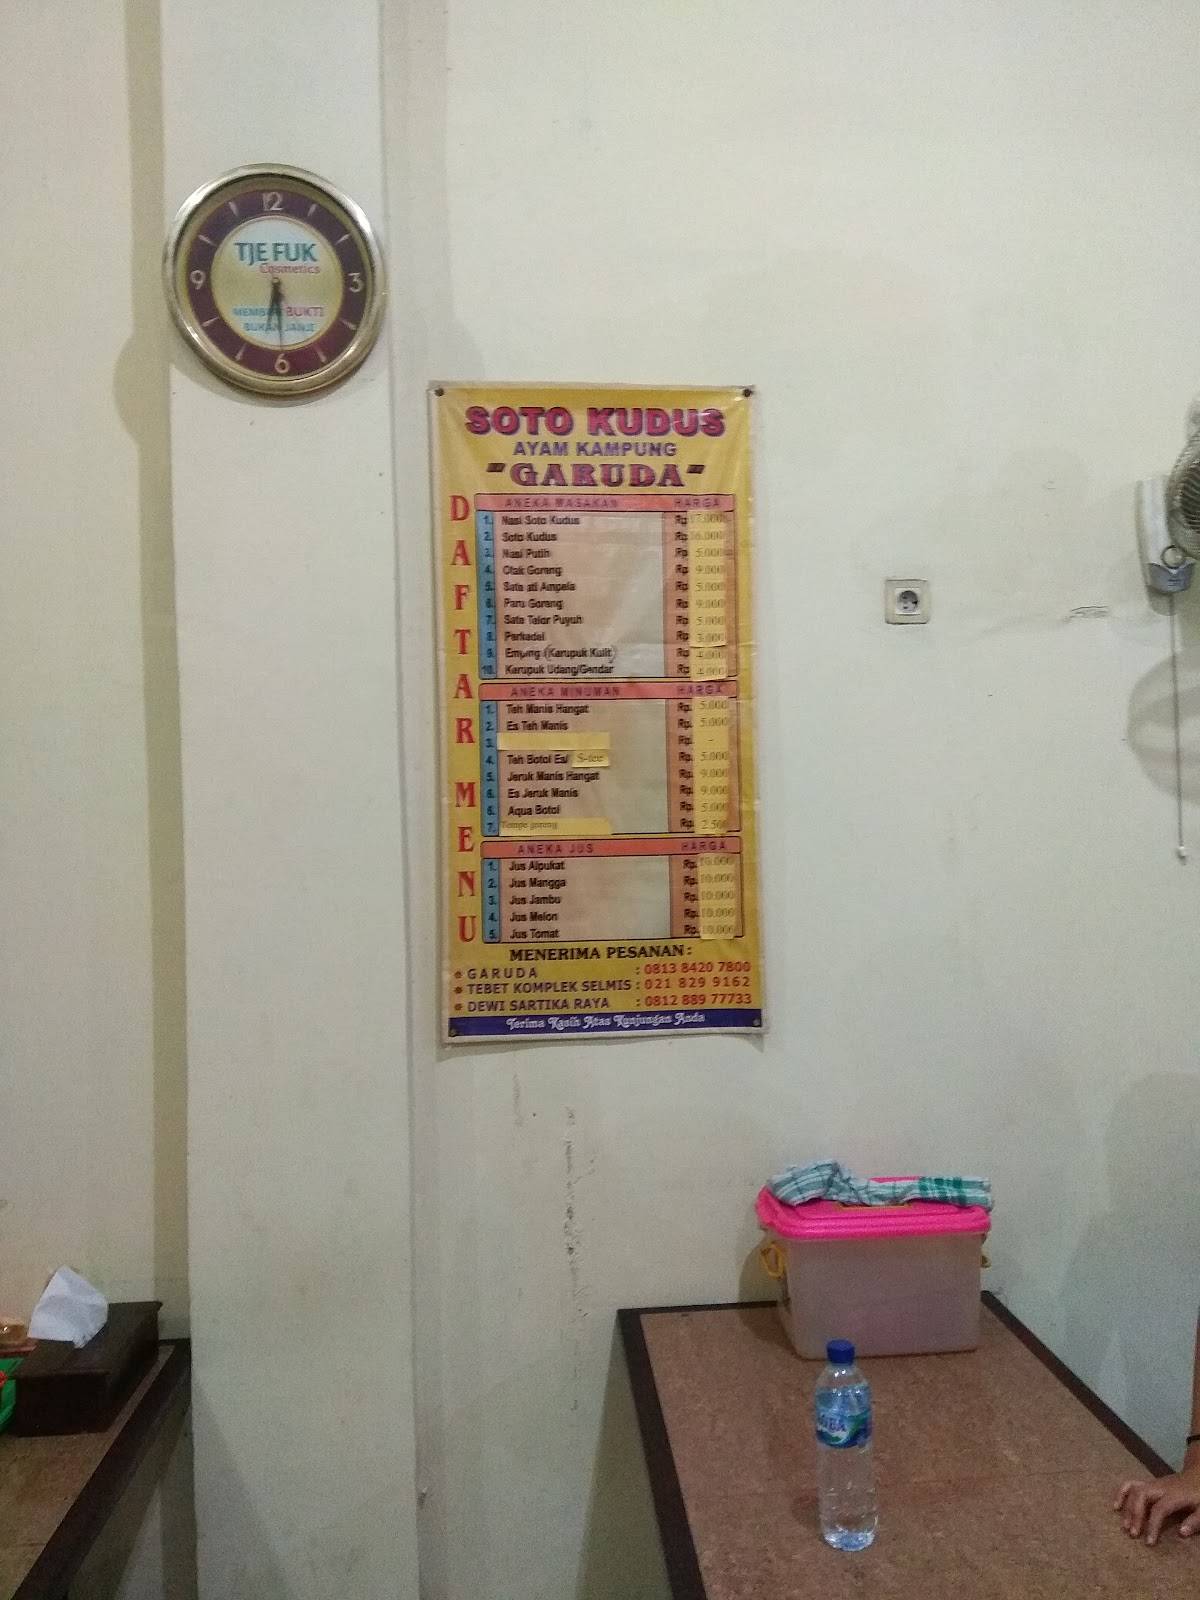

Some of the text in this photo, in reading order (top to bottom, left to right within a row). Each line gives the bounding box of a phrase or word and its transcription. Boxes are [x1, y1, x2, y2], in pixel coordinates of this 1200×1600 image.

[262, 192, 284, 211] 12
[233, 242, 318, 265] TJE FUK
[259, 263, 320, 274] Cosmetics
[189, 270, 206, 290] 9
[348, 272, 364, 292] 3
[274, 353, 290, 373] 6
[465, 406, 726, 437] SOTO KUDUS
[513, 441, 677, 457] AYAM KAMPUNG
[505, 498, 618, 508] ANEKA MASAKAN
[674, 498, 720, 508] HARGA
[502, 515, 522, 525] Nasi
[525, 515, 546, 525] Soto
[550, 515, 580, 525] Kudus
[502, 532, 524, 541] Soto
[526, 532, 557, 541] Kudus
[502, 549, 550, 558] Nasi Putih
[527, 565, 563, 577] Goreng
[528, 598, 564, 610] Goreng
[511, 687, 620, 697] ANEKA MINUMAN
[677, 685, 721, 695] HARGA
[506, 704, 524, 714] Teh
[526, 704, 553, 714] Manis
[556, 704, 589, 715] Hangat
[507, 721, 519, 731] Es
[521, 721, 538, 731] Teh
[541, 721, 568, 731] Manis
[507, 754, 524, 764] Teh
[527, 754, 552, 764] Botol
[507, 771, 534, 781] Jeruk
[536, 771, 563, 781] Manis
[566, 771, 600, 782] Hangat
[508, 789, 519, 798] Es
[522, 788, 548, 798] Jeruk
[551, 788, 578, 798] Manis
[508, 806, 532, 817] Aqua
[535, 805, 560, 814] Botol
[518, 843, 594, 854] ANEKA JUS
[681, 841, 725, 851] HARGA
[509, 861, 526, 871] Jus
[528, 861, 565, 872] Alpukat
[509, 878, 526, 888] Jus
[529, 878, 567, 889] Mangga
[509, 895, 526, 905] Jus
[529, 895, 561, 905] Jambu
[510, 912, 527, 922] Jus
[529, 912, 558, 921] Melon
[510, 929, 527, 939] Jus
[530, 928, 560, 939] Tomat
[510, 947, 600, 961] MENERIMA
[644, 961, 752, 974] 0813 8420 7800
[467, 968, 538, 980] GARUDA
[466, 979, 632, 995] TEBET KOMPLEK SELMIS
[644, 976, 750, 990] 021 829 9162
[467, 997, 609, 1012] DEWI SARTIKA RAYA
[645, 993, 752, 1007] 0812 889 77733
[506, 1012, 705, 1030] Terima Kasih Atas Kunjungan Anda
